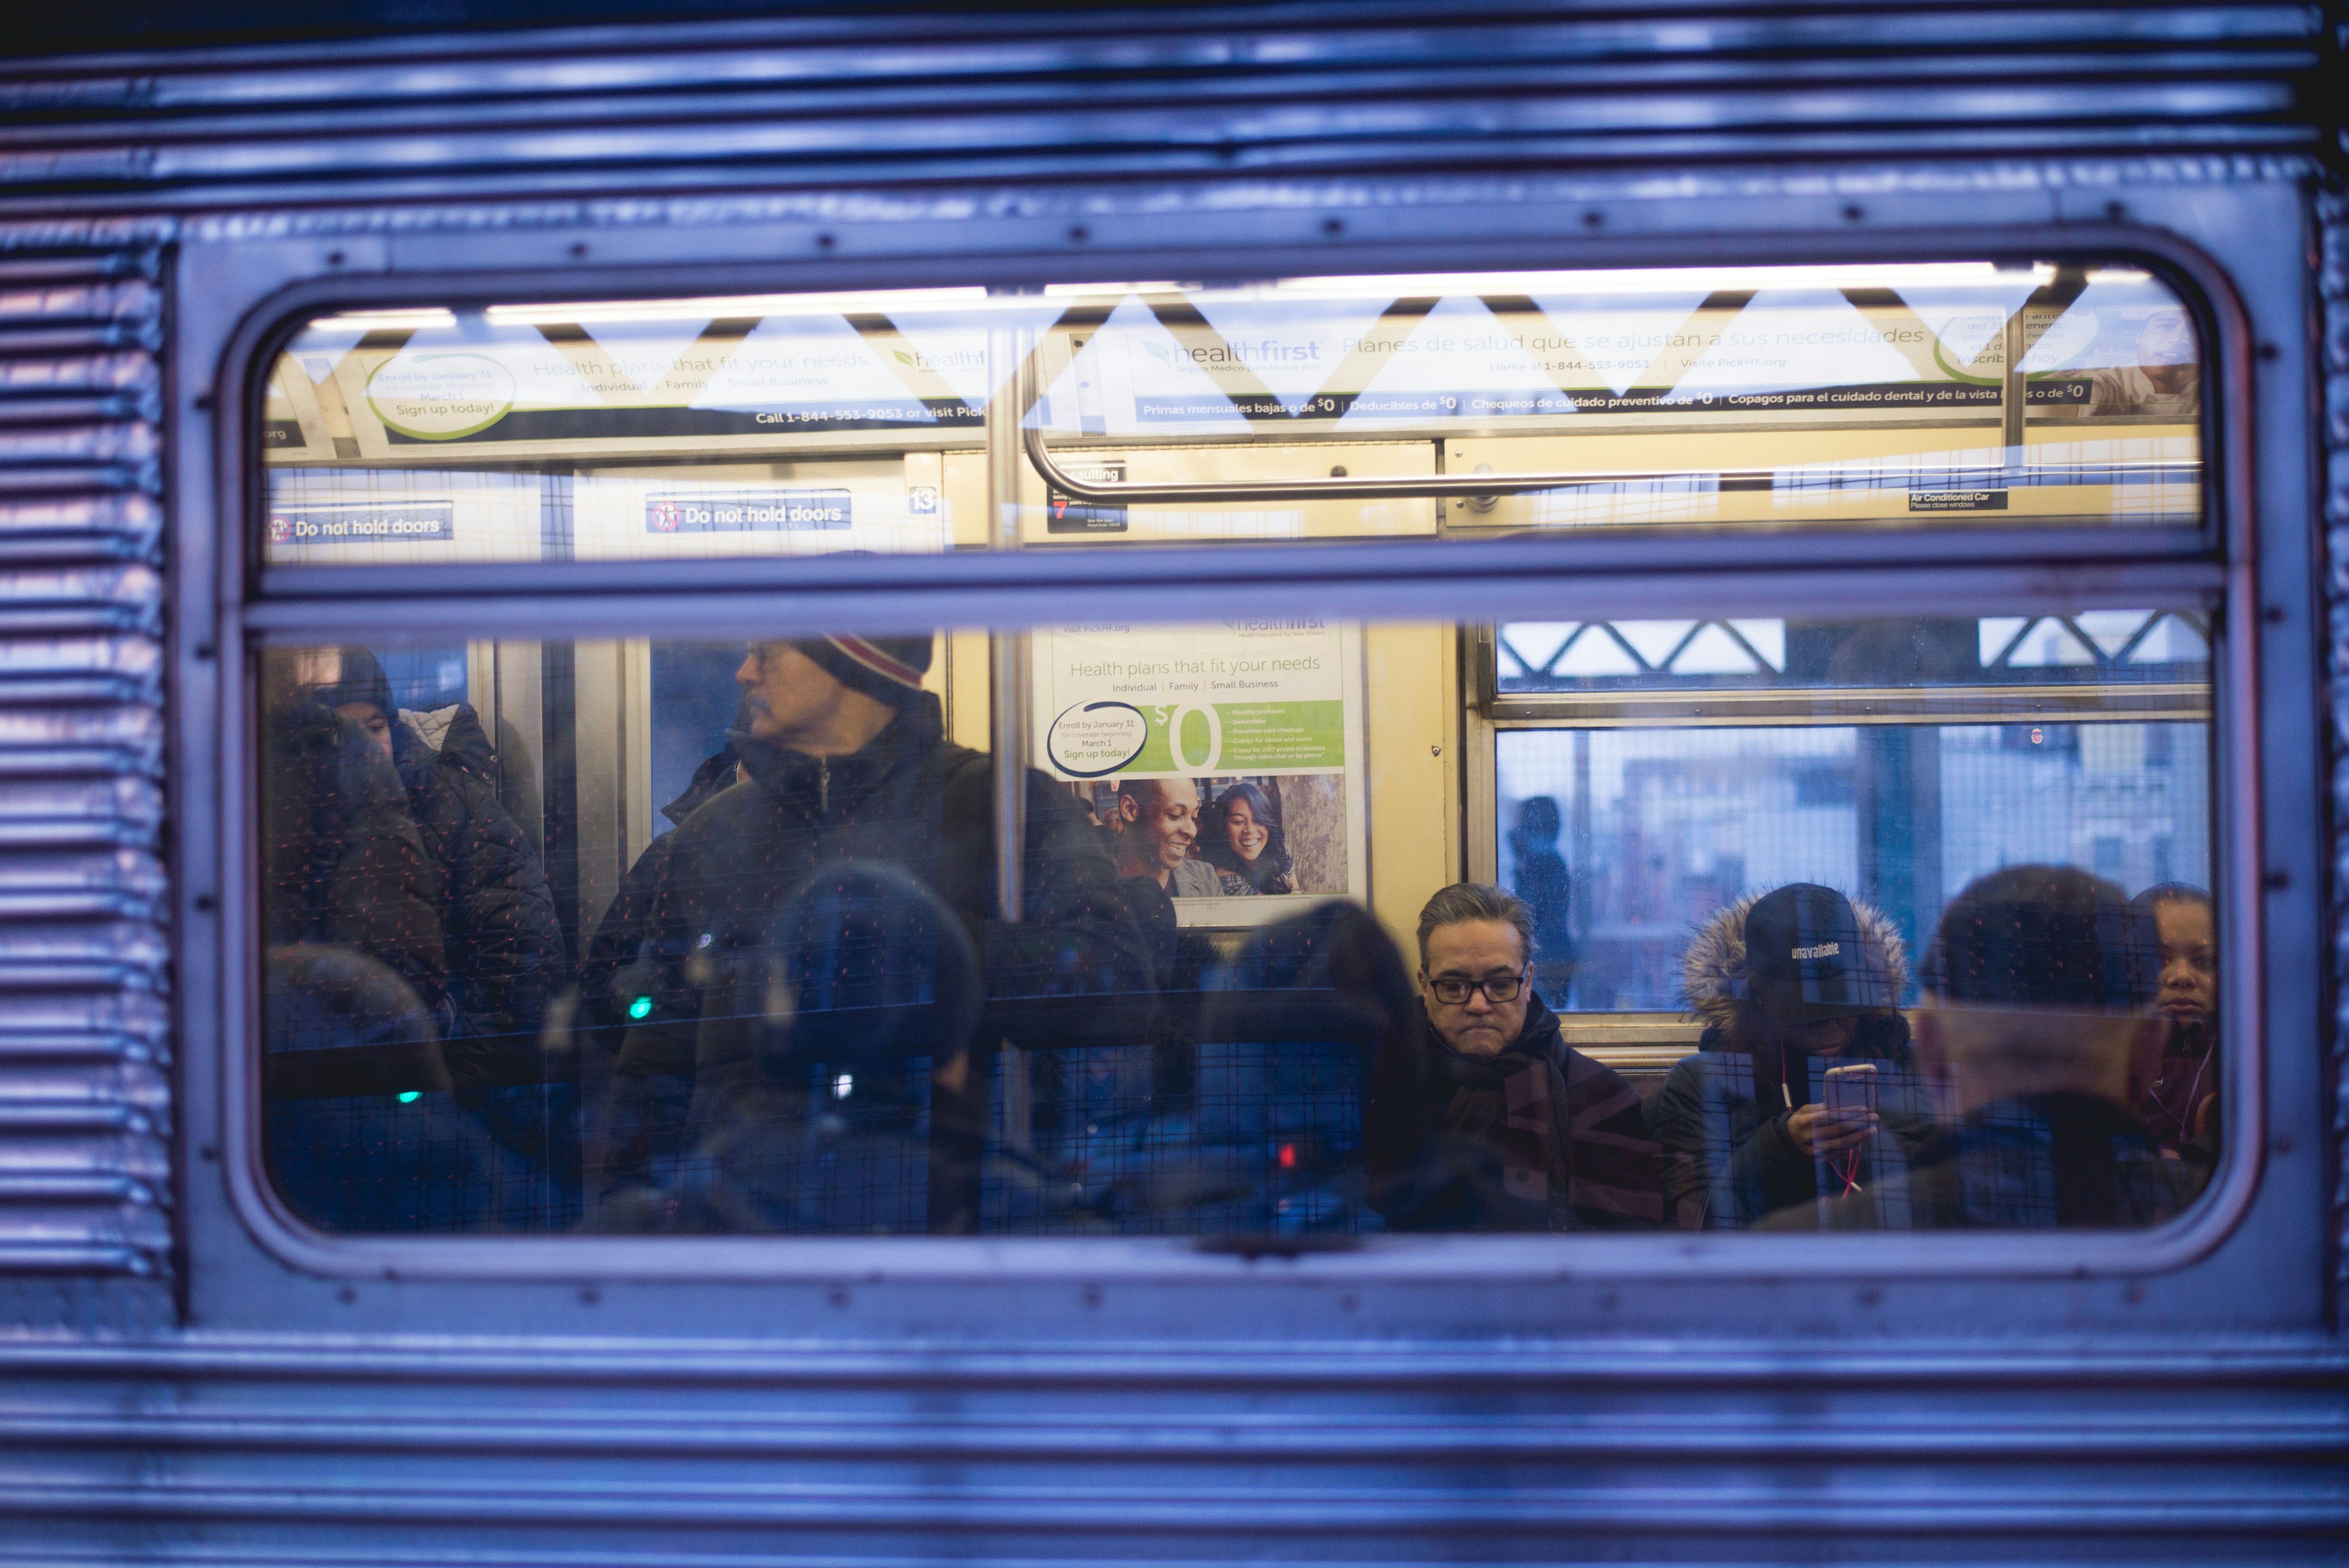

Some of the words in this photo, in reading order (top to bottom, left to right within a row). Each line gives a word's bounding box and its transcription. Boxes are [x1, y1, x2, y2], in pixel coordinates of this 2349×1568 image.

[1343, 338, 1418, 353] Planes
[1426, 337, 1455, 351] de
[1463, 335, 1523, 351] salud
[1532, 337, 1576, 353] que
[1585, 336, 1609, 349] se
[1618, 333, 1700, 351] ajustan
[1709, 334, 1721, 346] a
[1730, 332, 1768, 346] sus
[1776, 328, 1924, 345] necesidades
[1174, 340, 1320, 363] healthfirst
[533, 361, 603, 376] Health
[610, 358, 665, 377] plans
[674, 356, 714, 371] that
[720, 356, 740, 370] fit
[743, 357, 795, 373] your
[803, 353, 868, 369] needs
[1490, 363, 1526, 371] Llame
[1530, 362, 1540, 371] al
[1544, 360, 1649, 371] 1-844-553-9053
[1681, 358, 1714, 367] Visite
[1718, 358, 1786, 368] PickHF.org
[378, 373, 411, 383] Enroll
[414, 373, 428, 382] by
[431, 371, 476, 381] January
[582, 381, 647, 392] Individual
[666, 380, 709, 391] Family
[728, 378, 765, 387] Small
[770, 376, 829, 387] Business
[421, 393, 455, 401] March
[1144, 404, 1185, 415] Primas
[1187, 403, 1252, 414] mensuales
[1255, 403, 1286, 415] bajas
[1289, 405, 1297, 413] o
[1300, 403, 1315, 412] de
[1317, 398, 1335, 412] $0
[1350, 400, 1419, 412] Deducibles
[1421, 401, 1437, 410] de
[1439, 396, 1457, 410] $0
[1472, 398, 1535, 411] Chequeos
[1537, 398, 1553, 408] de
[1556, 397, 1606, 408] cuidado
[1608, 395, 1675, 408] preventivo
[1677, 395, 1693, 405] de
[1696, 391, 1713, 405] $0
[1729, 393, 1784, 406] Copagos
[1786, 394, 1815, 405] para
[1817, 392, 1828, 402] el
[1831, 391, 1882, 402] cuidado
[1884, 390, 1925, 401] dental
[1926, 391, 1935, 403] y
[1936, 390, 1952, 400] de
[1955, 390, 1966, 399] la
[1969, 390, 1998, 399] vista
[2049, 390, 2063, 399] de
[2067, 384, 2084, 397] $0
[396, 404, 426, 417] Sign
[431, 407, 448, 415] up
[451, 403, 494, 415] today!
[756, 412, 784, 423] Call
[786, 408, 902, 422] 1-844-553-9053
[906, 409, 921, 418] or
[924, 407, 954, 417] visit
[909, 490, 934, 510] 13
[1924, 493, 1973, 502] Conditioned
[1975, 493, 1990, 501] Car
[686, 508, 710, 524] Do
[715, 509, 743, 523] not
[747, 506, 786, 522] hold
[790, 505, 842, 522] doors
[1053, 501, 1068, 519] 7
[296, 521, 318, 536] Do
[323, 521, 349, 535] not
[353, 519, 388, 535] hold
[392, 517, 440, 534] doors
[1063, 625, 1081, 633] Visit
[1084, 624, 1130, 633] PickHF.org
[1071, 661, 1122, 676] Health
[1128, 661, 1169, 679] plans
[1174, 659, 1205, 673] that
[1211, 658, 1225, 673] fit
[1230, 660, 1267, 676] your
[1272, 656, 1320, 671] needs
[1112, 683, 1157, 692] Individual
[1169, 682, 1199, 691] Family
[1211, 681, 1236, 689] Small
[1239, 680, 1278, 688] Business
[1082, 722, 1092, 731] by
[1093, 720, 1124, 730] January
[1101, 731, 1132, 739] beginning
[1154, 702, 1222, 772] $0
[1082, 739, 1106, 748] March
[1064, 750, 1084, 760] Sign
[1100, 748, 1130, 759] today!
[1791, 941, 1840, 959] unavailable
